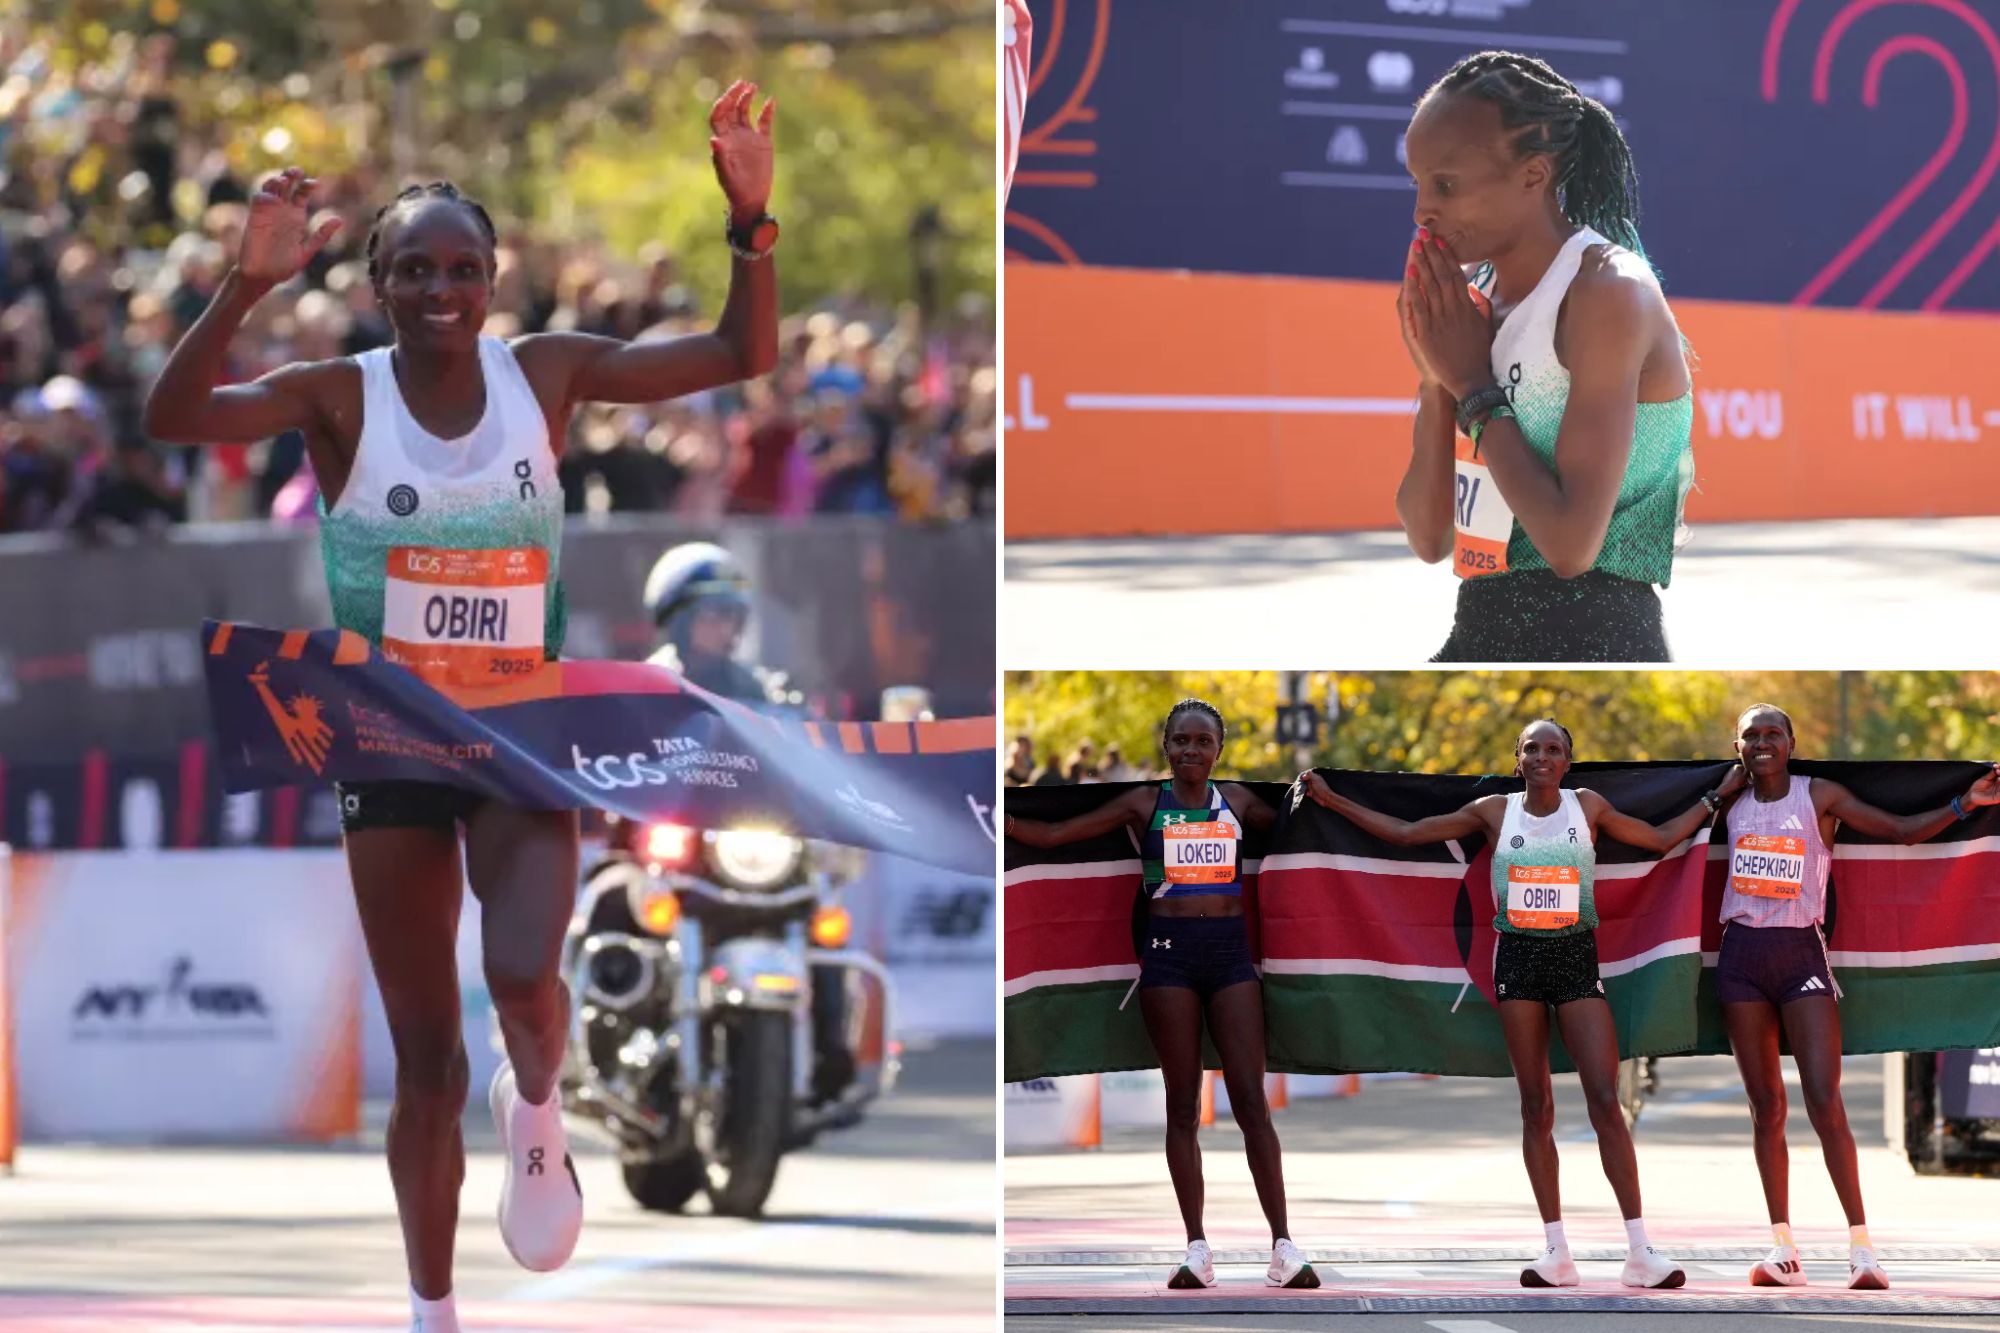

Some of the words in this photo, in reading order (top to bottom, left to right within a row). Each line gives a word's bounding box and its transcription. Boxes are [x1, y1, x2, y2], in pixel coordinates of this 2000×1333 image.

[1700, 389, 1783, 439] YOU
[1853, 393, 1887, 439] IT
[1896, 394, 1980, 441] WILL
[1460, 548, 1497, 570] 2025
[424, 595, 508, 642] OBIRI
[489, 659, 534, 674] 2025
[653, 737, 700, 754] TATA
[572, 744, 667, 790] tcs
[1177, 843, 1226, 864] LOKEDI
[1214, 870, 1232, 878] 2025
[1735, 854, 1801, 879] CHEPKIRUI
[1523, 888, 1560, 908] OBIRI
[1553, 916, 1575, 924] 2025
